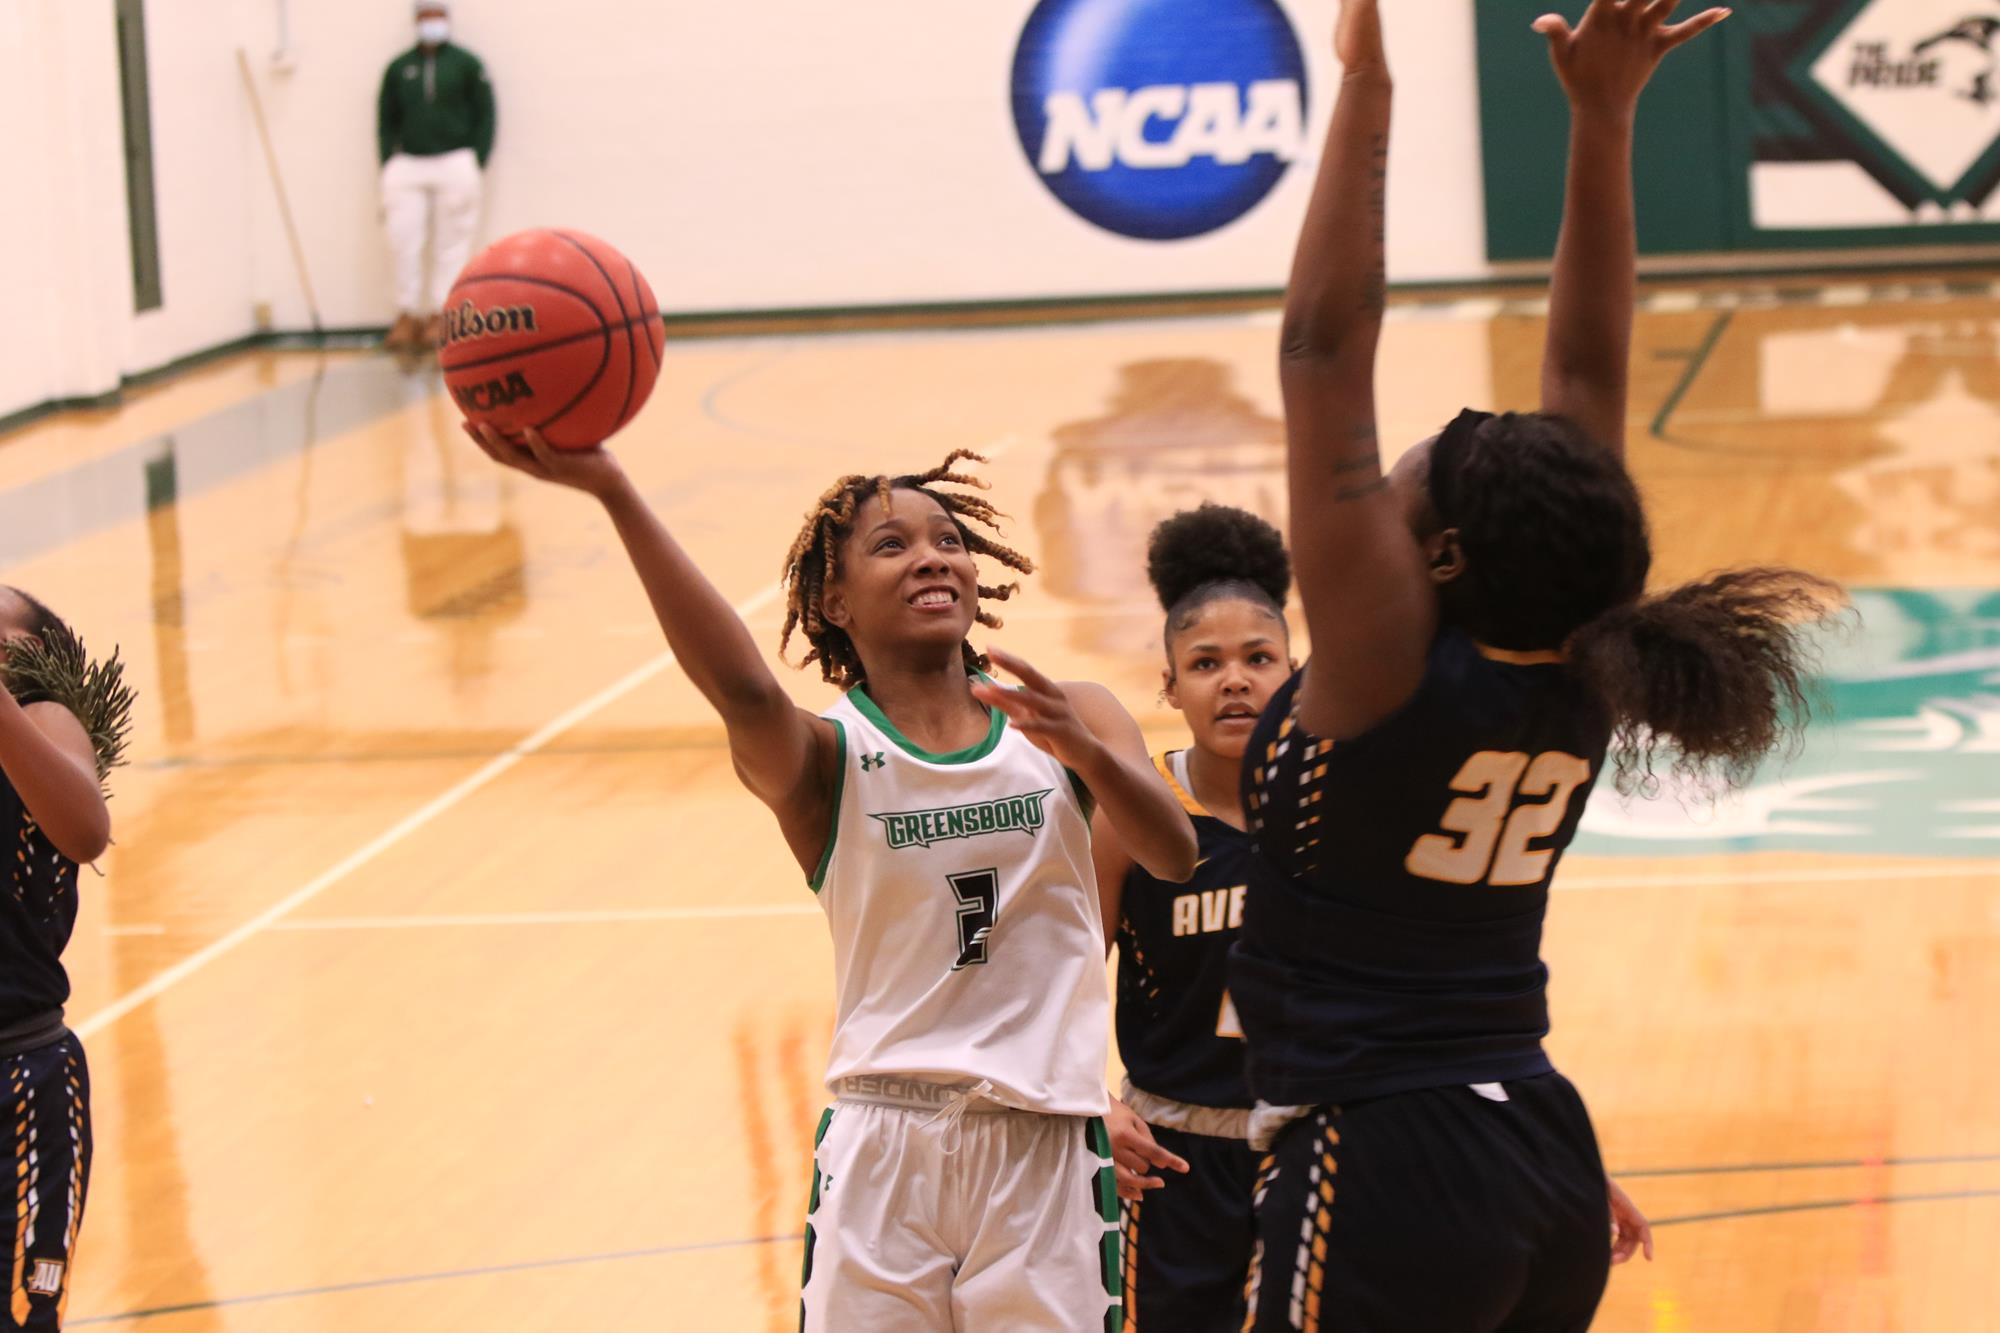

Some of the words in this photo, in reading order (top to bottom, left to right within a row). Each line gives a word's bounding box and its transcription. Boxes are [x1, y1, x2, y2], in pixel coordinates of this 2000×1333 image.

[1039, 80, 1307, 173] NCAA
[876, 792, 1048, 849] GREENSBORO
[1404, 751, 1591, 886] 32
